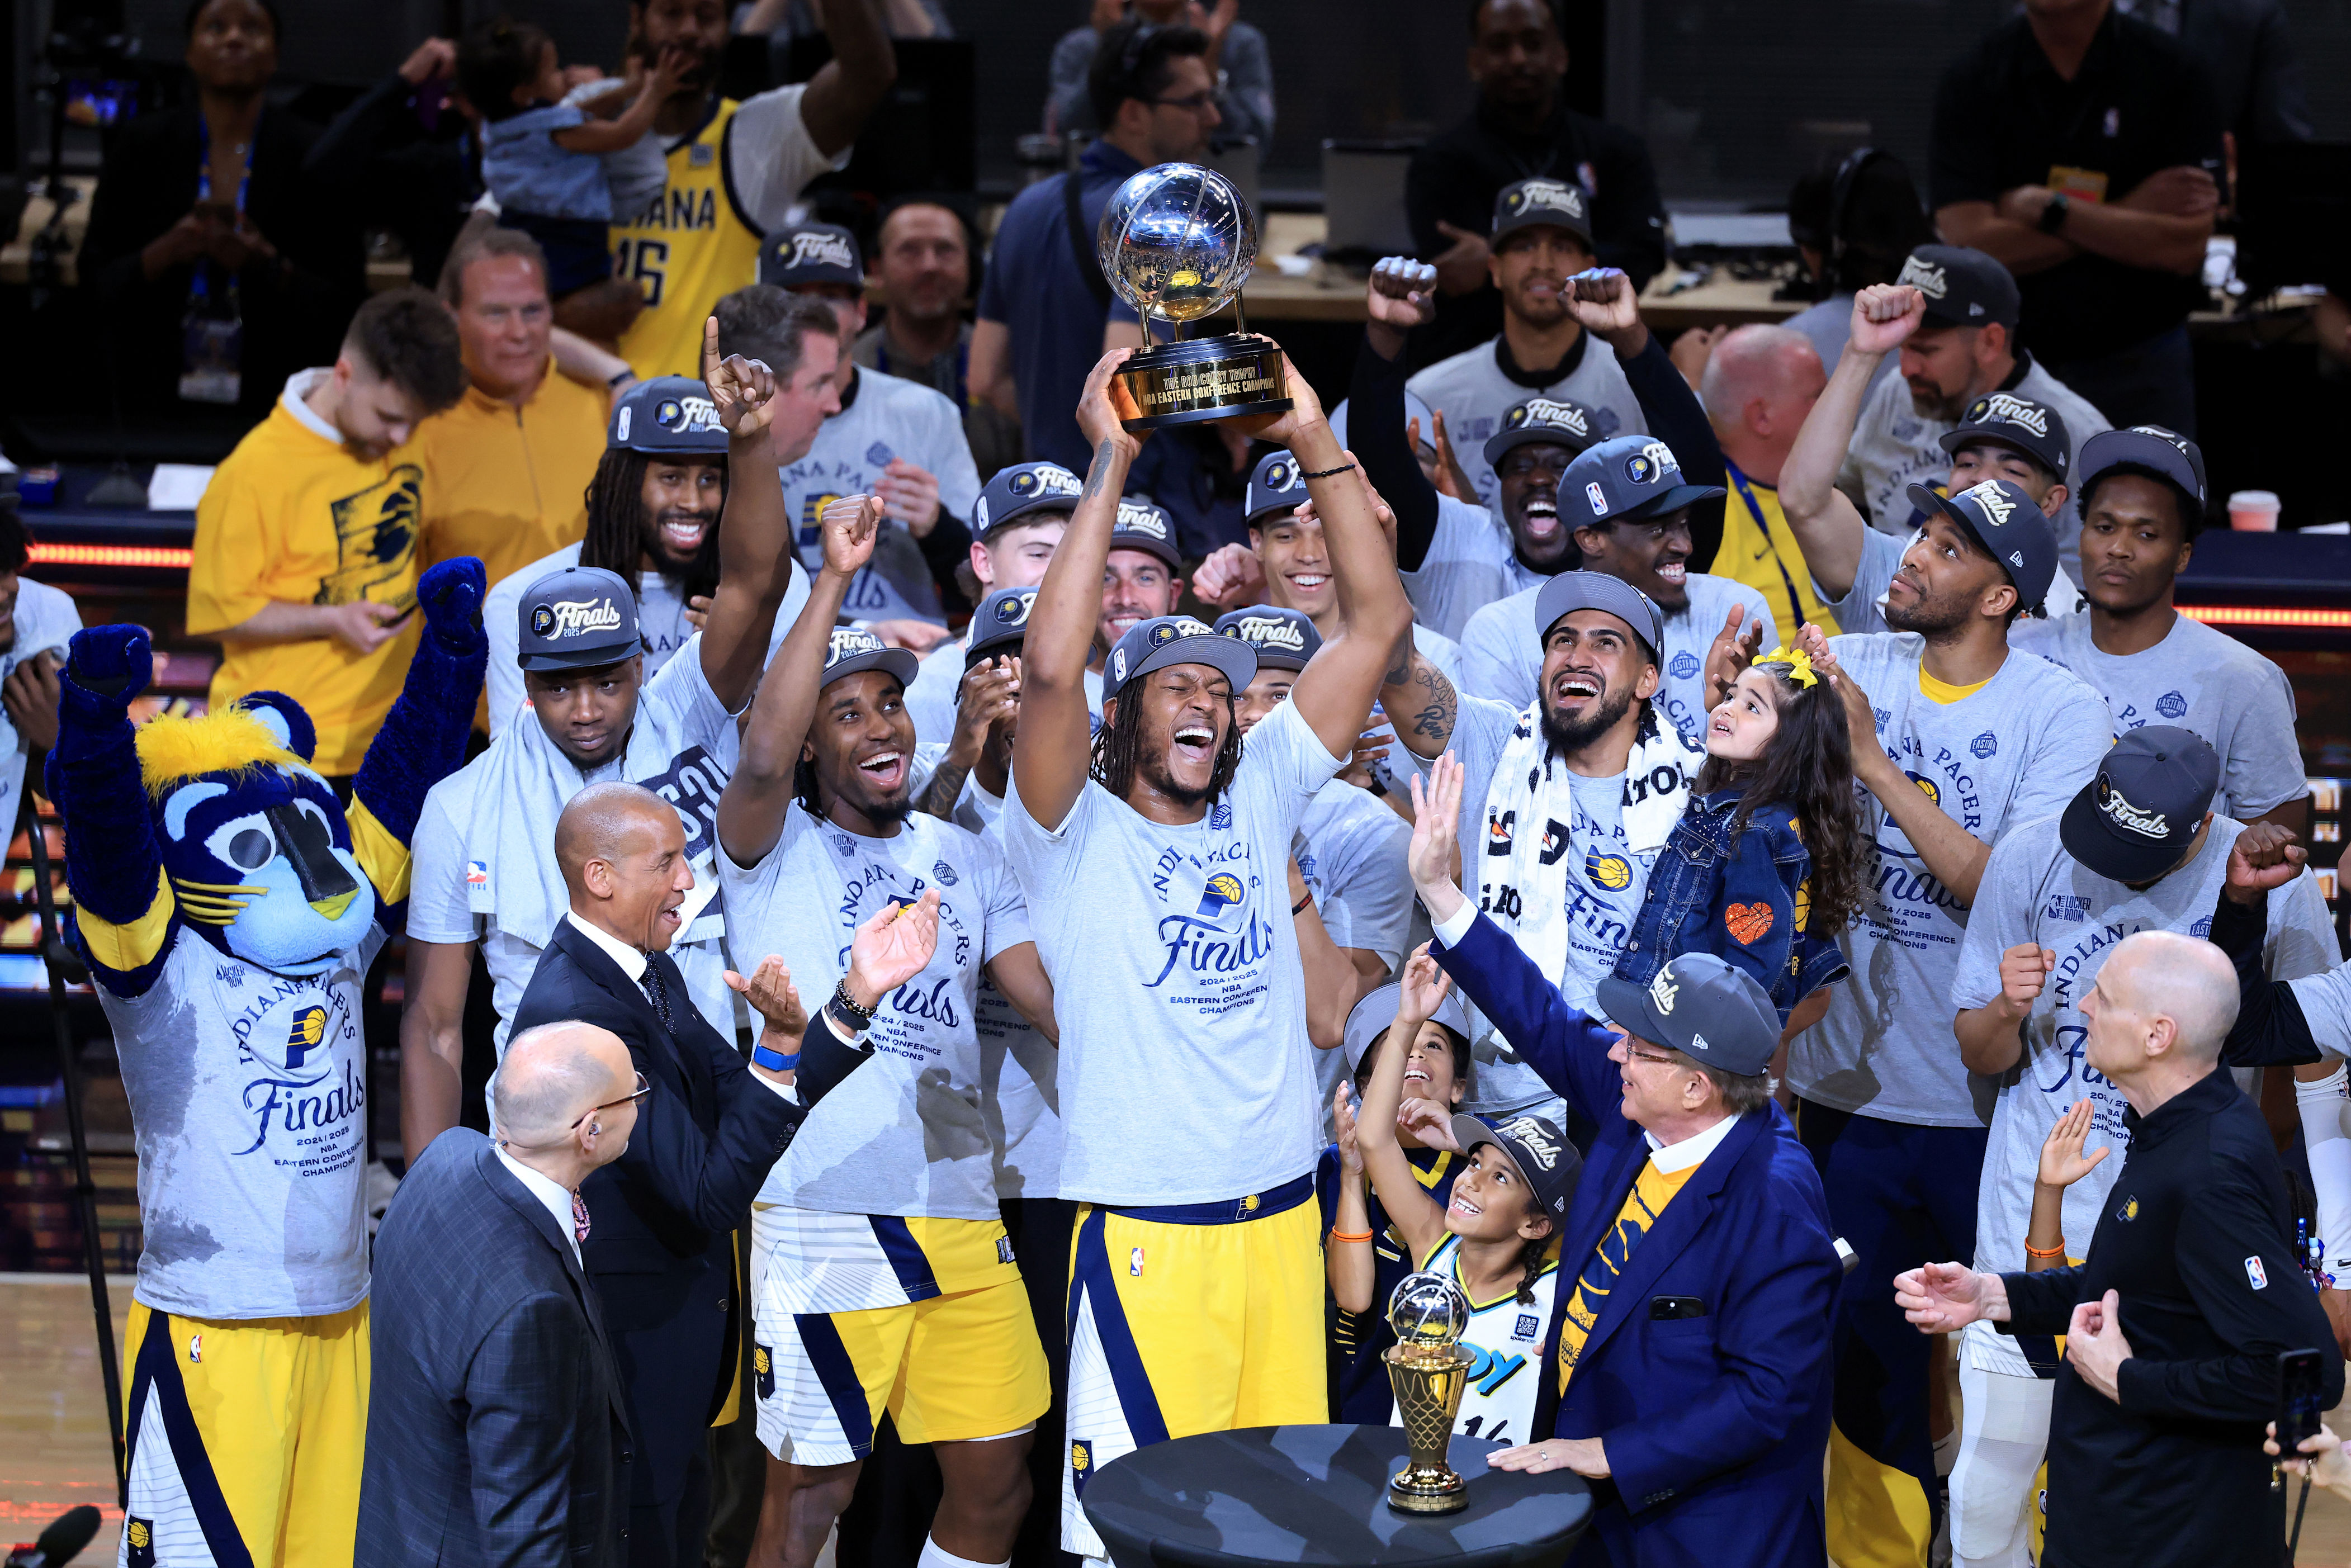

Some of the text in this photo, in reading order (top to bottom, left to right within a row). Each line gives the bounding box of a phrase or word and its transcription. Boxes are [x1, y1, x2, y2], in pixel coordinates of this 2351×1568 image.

[1163, 377, 1179, 390] THE
[1181, 375, 1198, 388] BOB
[1229, 367, 1256, 381] TROPHY
[1158, 389, 1191, 404] EASTERN
[1194, 382, 1241, 399] CONFERENCE
[1242, 377, 1275, 391] CHAMPIONS
[1521, 399, 1588, 437] Finals
[1975, 394, 2048, 438] Finals
[1029, 466, 1084, 499] Final
[547, 598, 621, 641] Finals
[564, 627, 580, 638] 2025
[1239, 616, 1304, 652] Finals
[840, 648, 858, 660] 2025
[1670, 659, 1700, 673] EASTERN
[2157, 698, 2187, 713] EASTERN
[1932, 747, 1981, 839] PACER
[2099, 789, 2170, 839] Finals
[2110, 812, 2123, 827] 2025
[2065, 895, 2092, 911] LOCKER
[909, 877, 970, 967] PCERS
[1887, 916, 1908, 926] NBA
[1903, 909, 1932, 920] 2025
[2064, 908, 2084, 923] ROOM
[1891, 925, 1956, 944] ONFERENCE
[1200, 978, 1226, 986] 2024
[1232, 969, 1259, 980] 2025
[1222, 984, 1242, 994] NBA
[1223, 985, 1268, 1003] CONFEREN
[981, 998, 1009, 1007] 2025
[1199, 998, 1255, 1014] CHAMPIONS
[886, 1027, 907, 1038] NBA
[903, 1020, 925, 1032] 2025
[892, 1039, 942, 1056] ONFERENCE
[231, 1058, 364, 1155] Finals
[297, 1136, 323, 1146] 2024
[329, 1125, 350, 1140] 2025
[1503, 1130, 1520, 1140] 2025
[320, 1143, 338, 1154] NBA
[1493, 1116, 1563, 1172] Finals
[275, 1158, 319, 1167] EATERN
[302, 1156, 356, 1177] CHAMPIONS
[1510, 1335, 1536, 1344] spokenote
